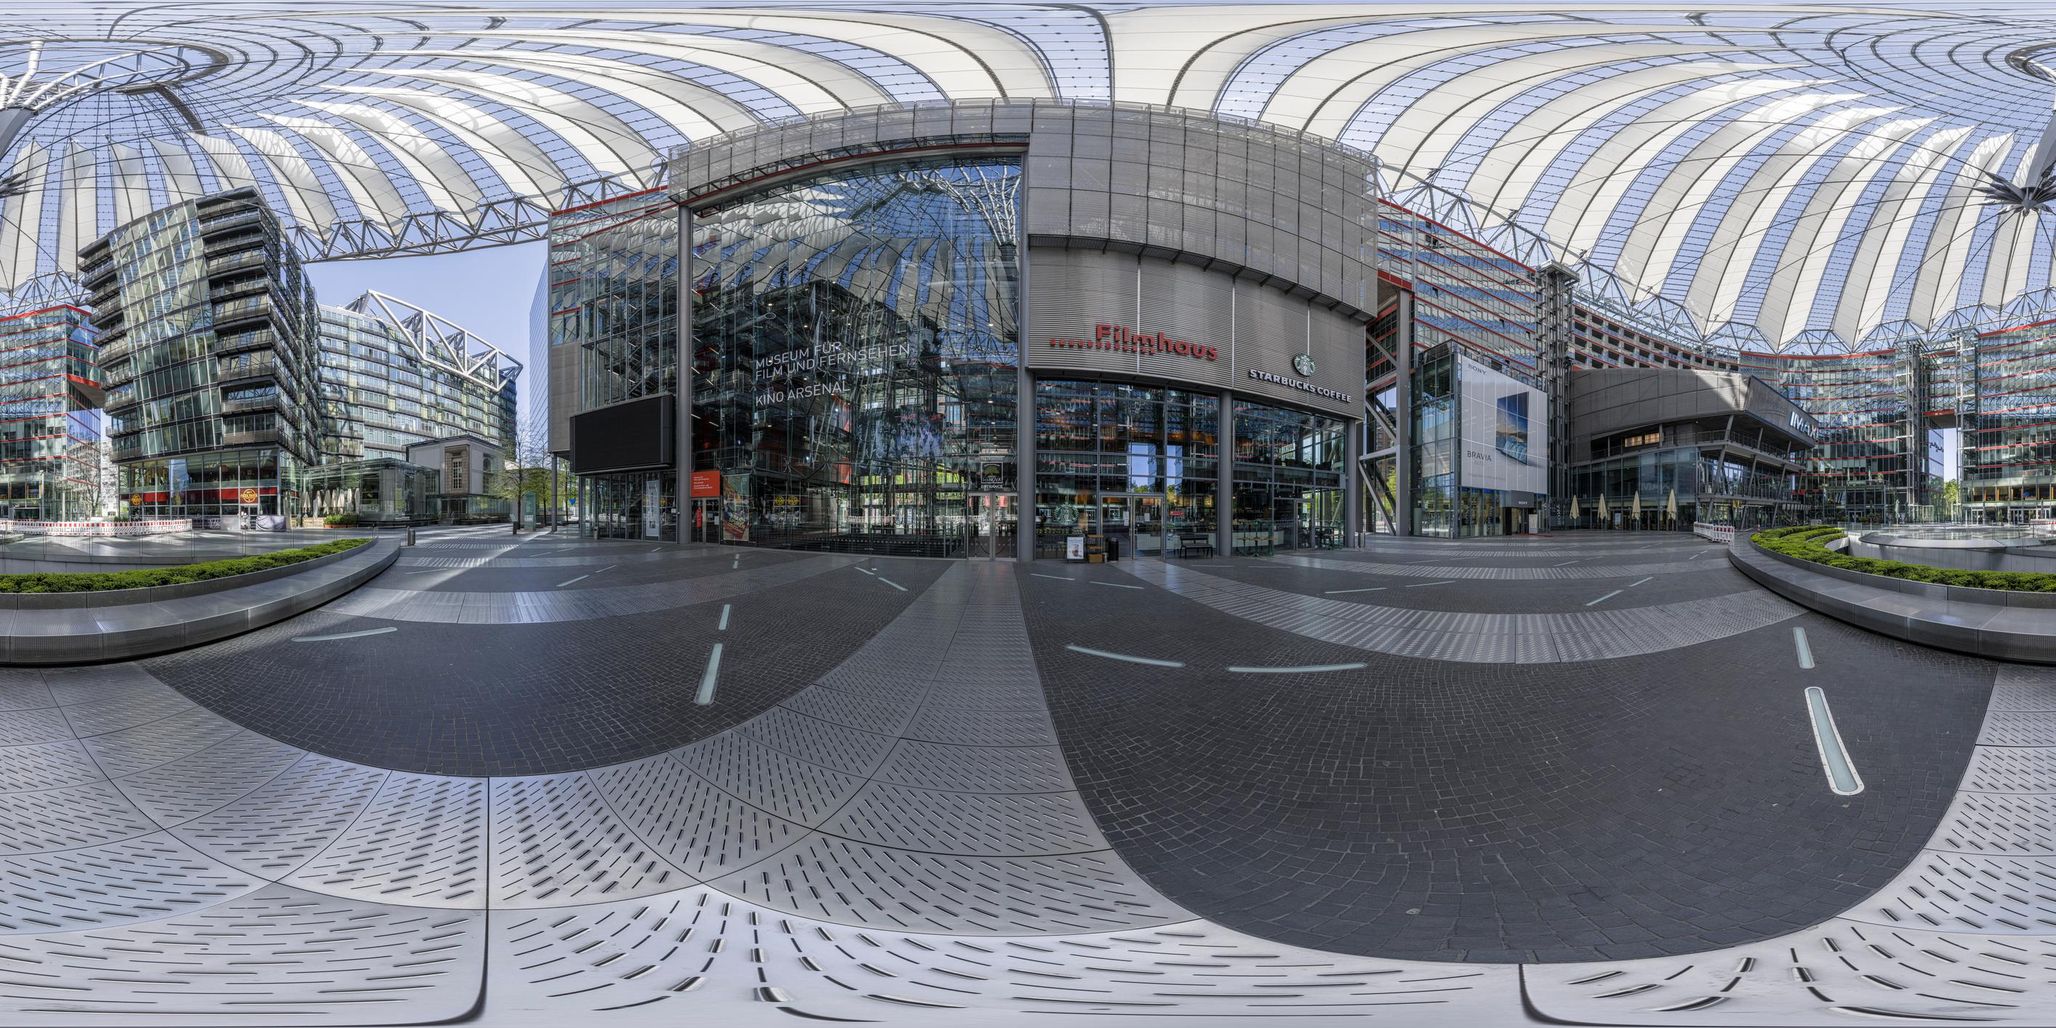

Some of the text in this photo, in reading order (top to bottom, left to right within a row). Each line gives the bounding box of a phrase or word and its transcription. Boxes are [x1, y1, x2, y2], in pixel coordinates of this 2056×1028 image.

[755, 340, 842, 370] MUSEUM FÜR
[1094, 323, 1218, 361] Filmhaus
[755, 343, 911, 381] FILM UND FERNSEHEN
[755, 380, 851, 407] KINO ARSENAL
[1248, 368, 1352, 404] STARBUCKS COFFEE
[1789, 411, 1819, 440] IMAX
[1466, 450, 1492, 462] BRAVIA
